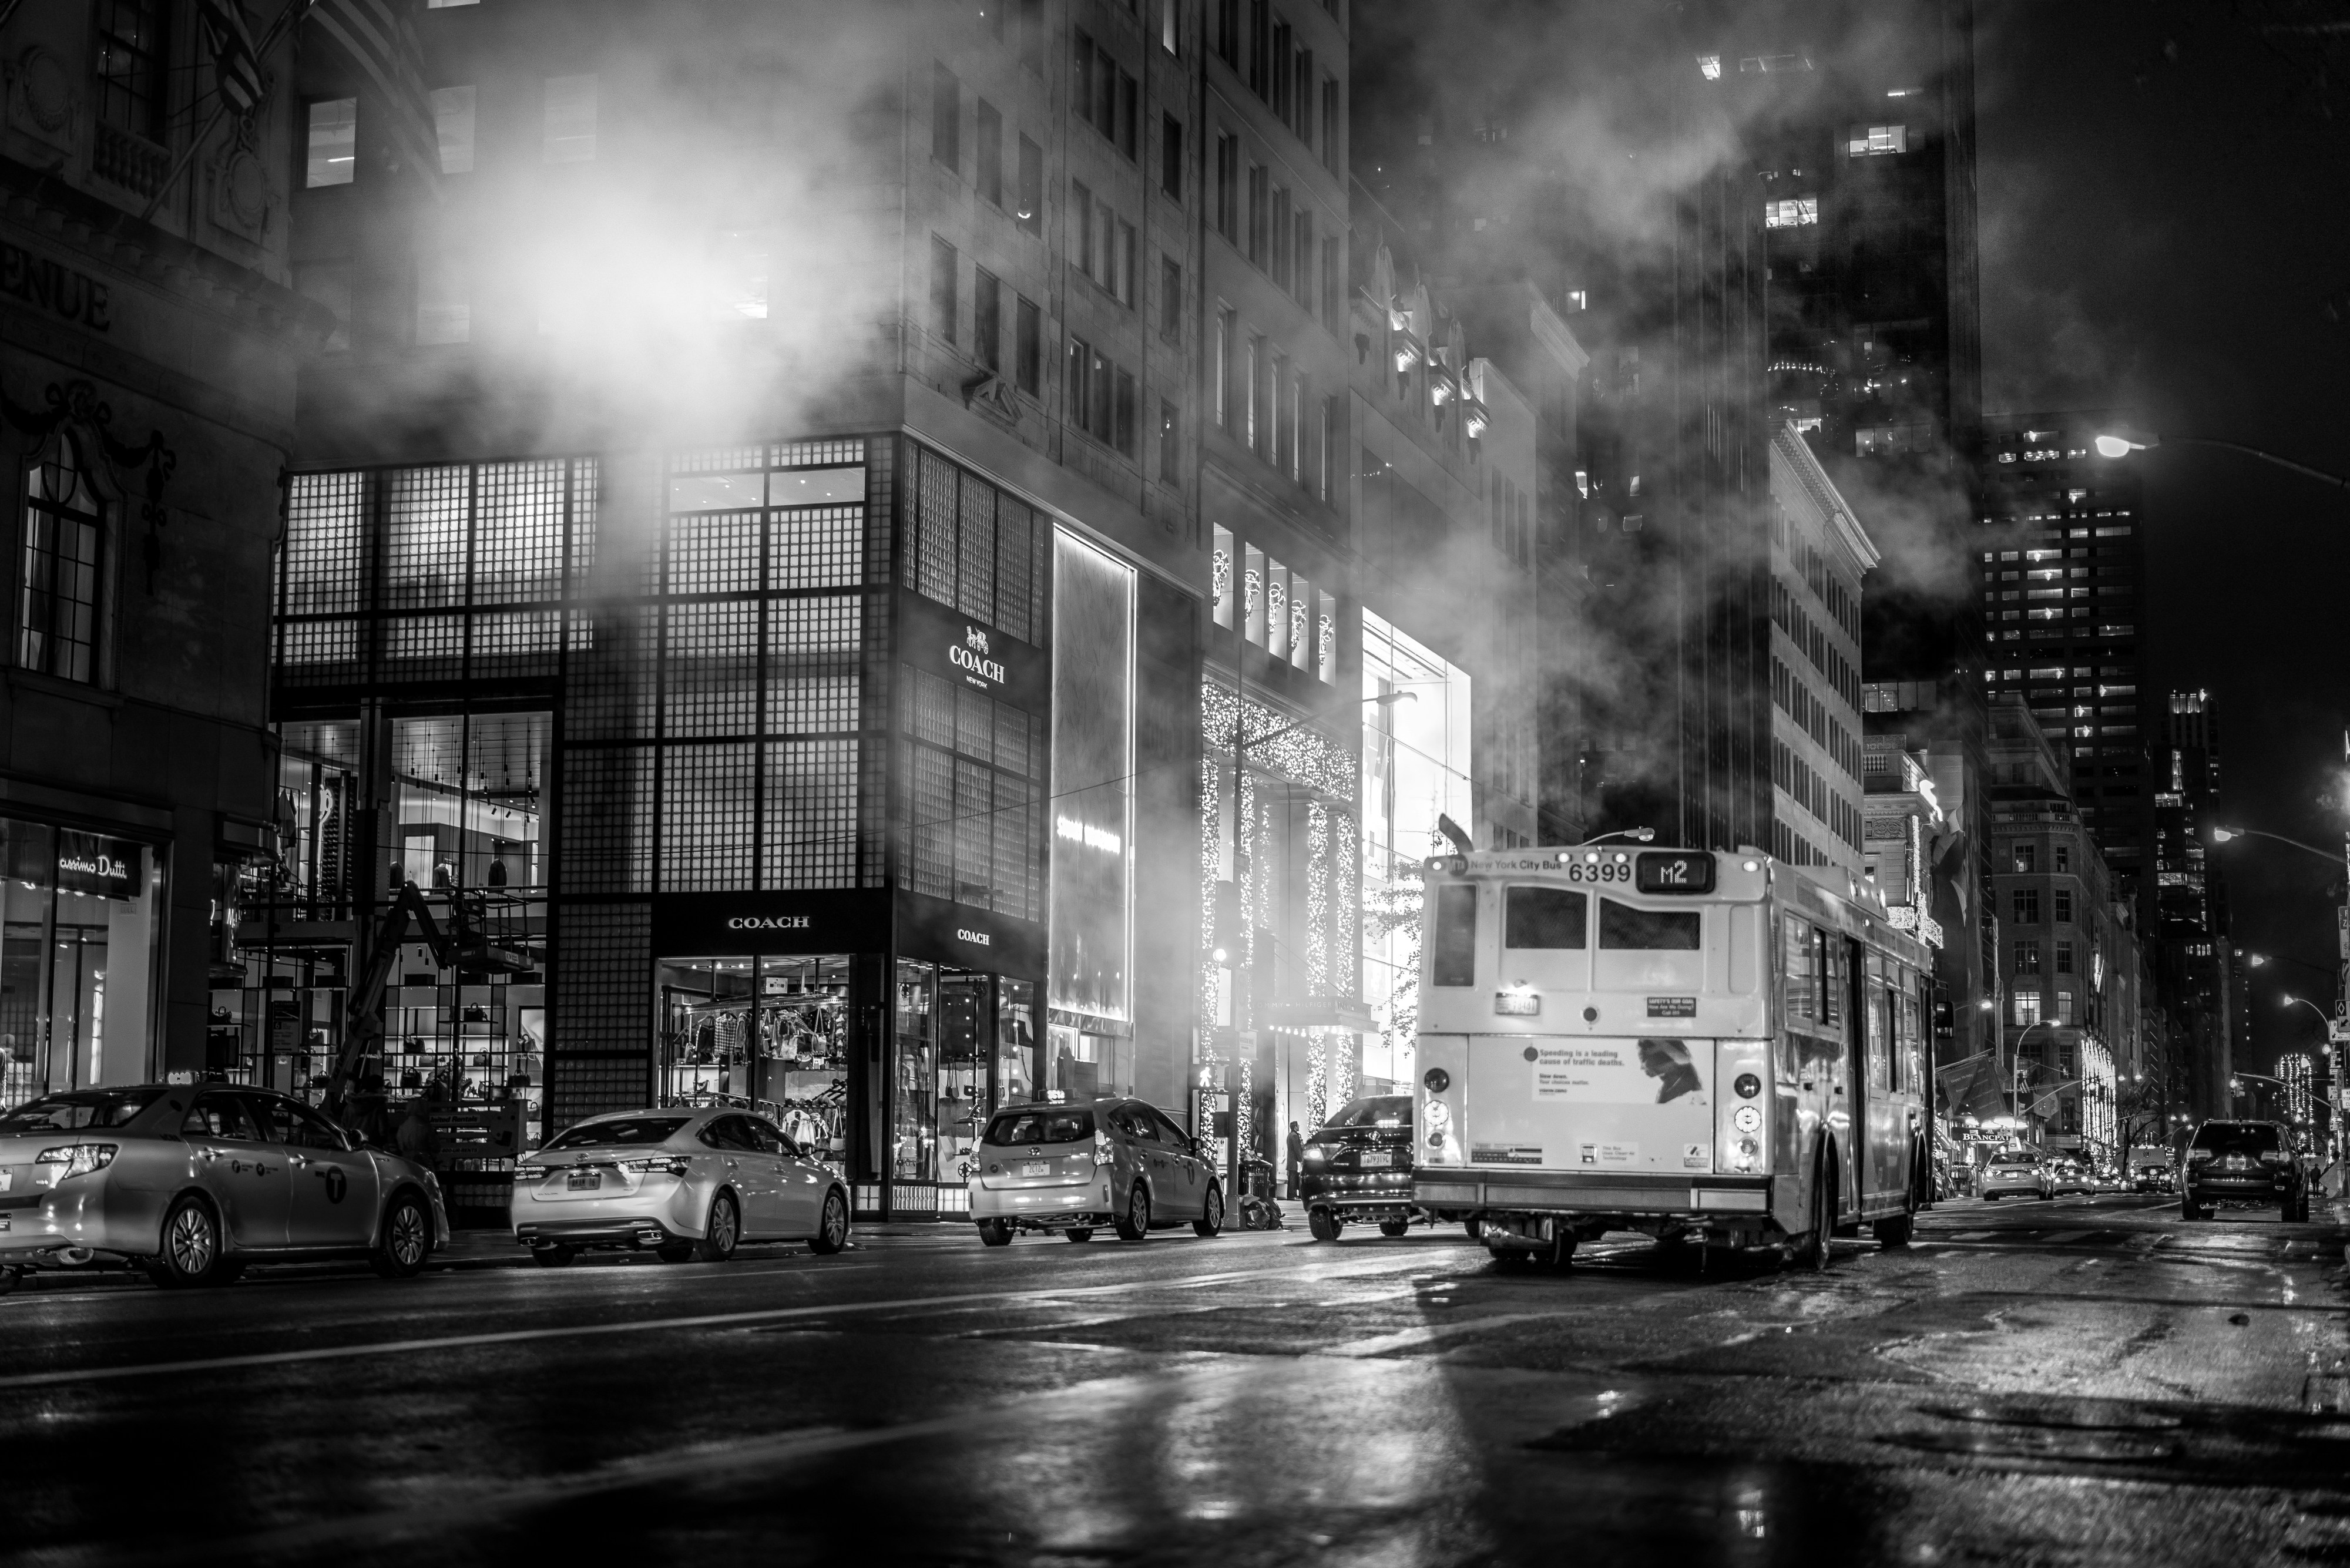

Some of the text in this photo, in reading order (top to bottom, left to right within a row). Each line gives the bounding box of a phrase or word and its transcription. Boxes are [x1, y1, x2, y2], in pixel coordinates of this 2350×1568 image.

[949, 645, 1004, 684] COACH
[966, 675, 988, 689] NEW YORK
[60, 855, 127, 879] assimo Dutti
[1471, 859, 1562, 872] New York City Bus
[1569, 864, 1631, 882] 6399
[1661, 860, 1687, 884] M2
[728, 916, 810, 929] COACH
[957, 929, 989, 945] COACH
[1540, 1049, 1573, 1058] Speeding
[1591, 1050, 1618, 1059] leading
